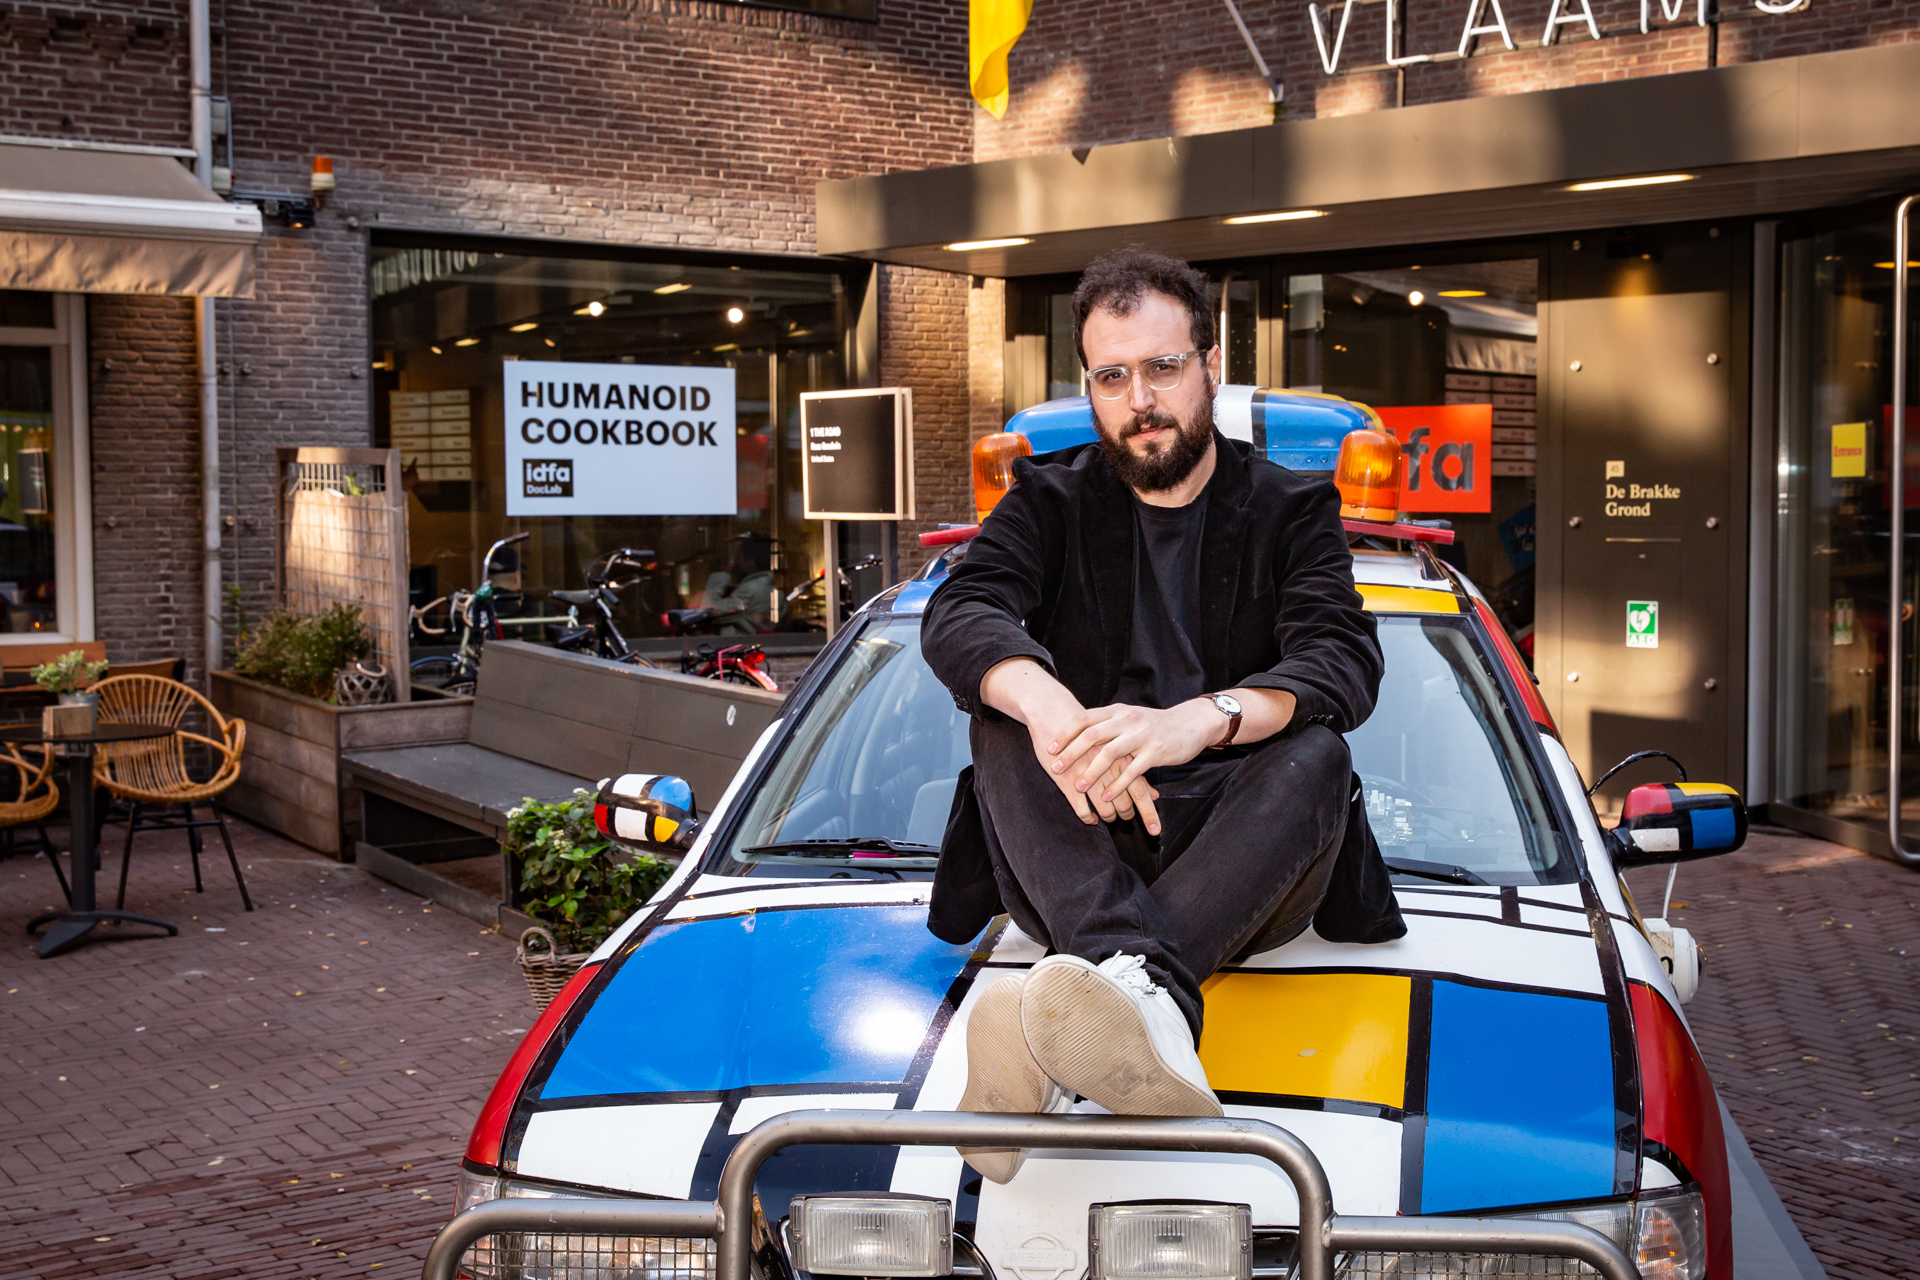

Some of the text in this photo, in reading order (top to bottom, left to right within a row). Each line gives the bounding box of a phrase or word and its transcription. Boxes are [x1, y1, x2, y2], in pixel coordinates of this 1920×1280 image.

[1309, 0, 1804, 74] VLAA
[521, 381, 711, 411] HUMANOID
[521, 417, 718, 446] COOKBOOK
[1385, 426, 1475, 492] fa
[1833, 445, 1863, 458] Entrance
[526, 462, 571, 483] idfa
[526, 483, 563, 495] DocLab
[1605, 484, 1681, 499] De Brakke
[1605, 501, 1651, 517] Grond
[1629, 634, 1656, 645] AED
[1009, 1251, 1072, 1264] NISSAN
